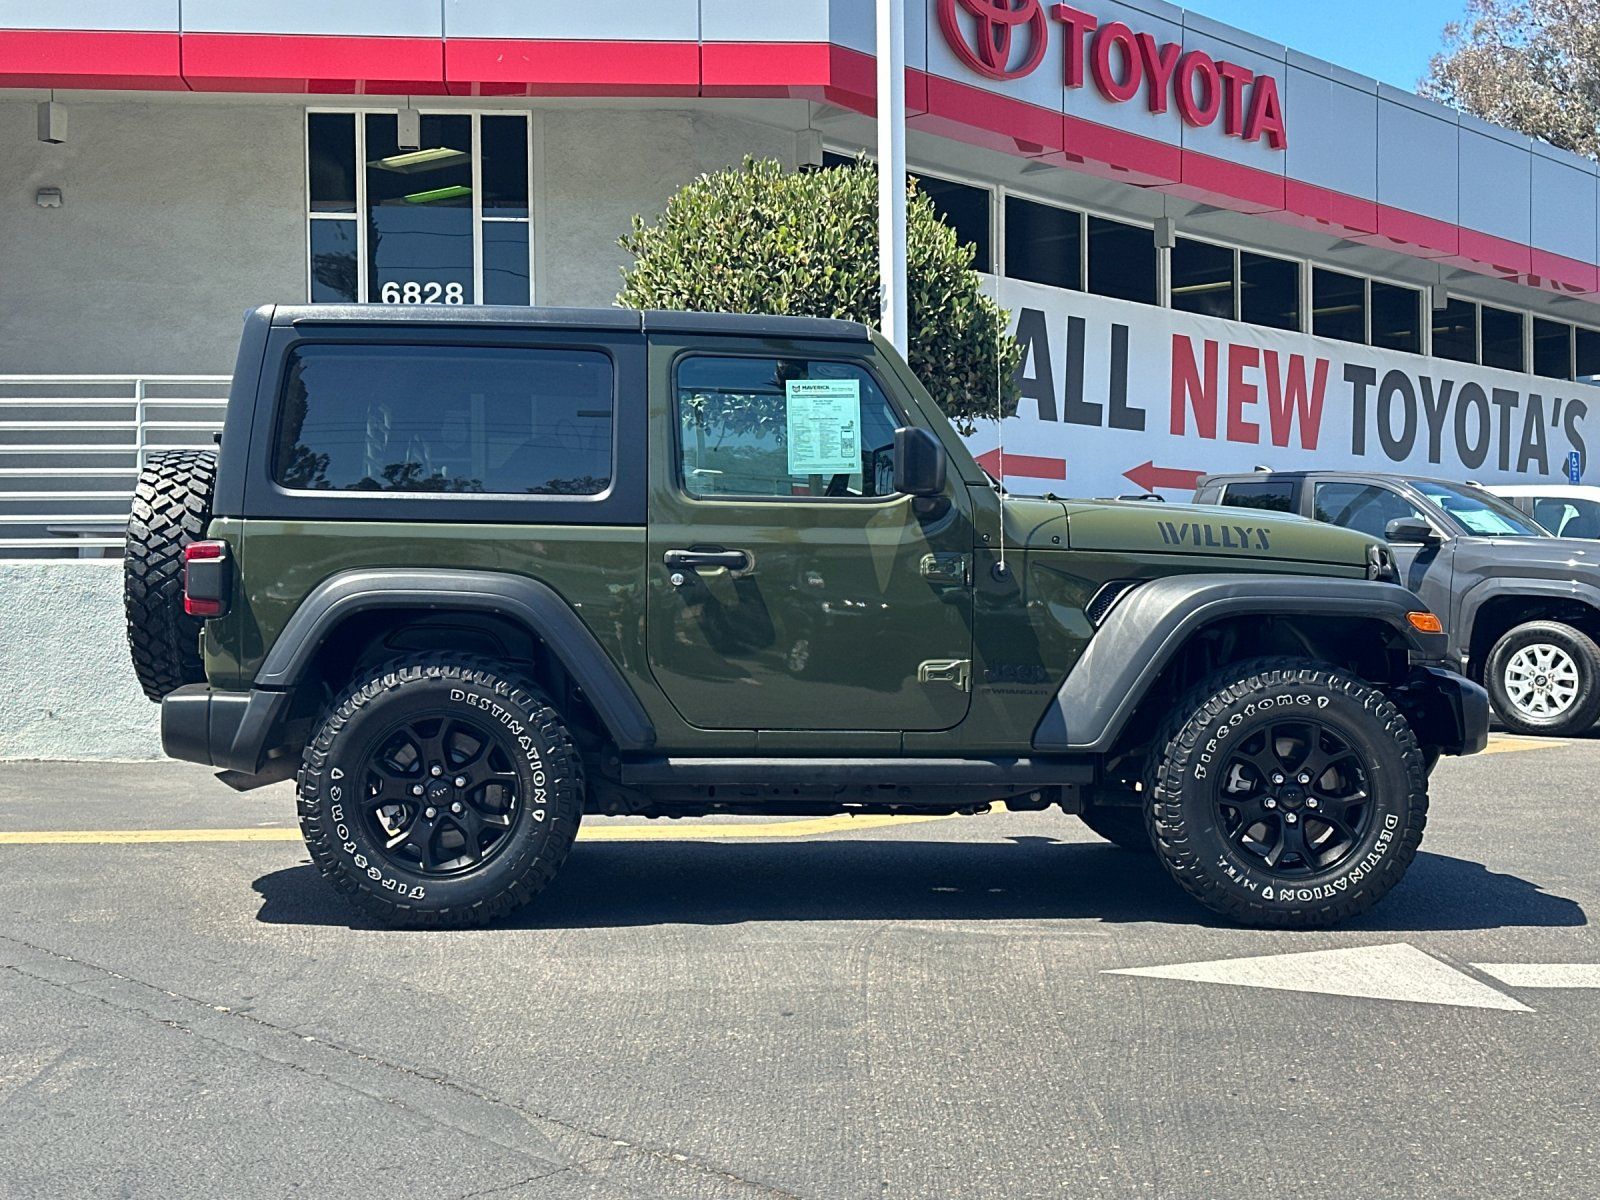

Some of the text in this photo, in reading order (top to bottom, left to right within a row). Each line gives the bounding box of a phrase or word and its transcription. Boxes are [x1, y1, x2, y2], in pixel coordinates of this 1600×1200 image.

[1051, 3, 1287, 150] TOYOTA
[381, 281, 464, 305] 6828
[1012, 307, 1588, 479] ALL NEW TOYOTA'S
[1157, 521, 1271, 550] WILLYS
[991, 687, 1048, 695] WRANGLER
[450, 688, 547, 804] DESTINATION
[1280, 813, 1398, 901] DESTINATION
